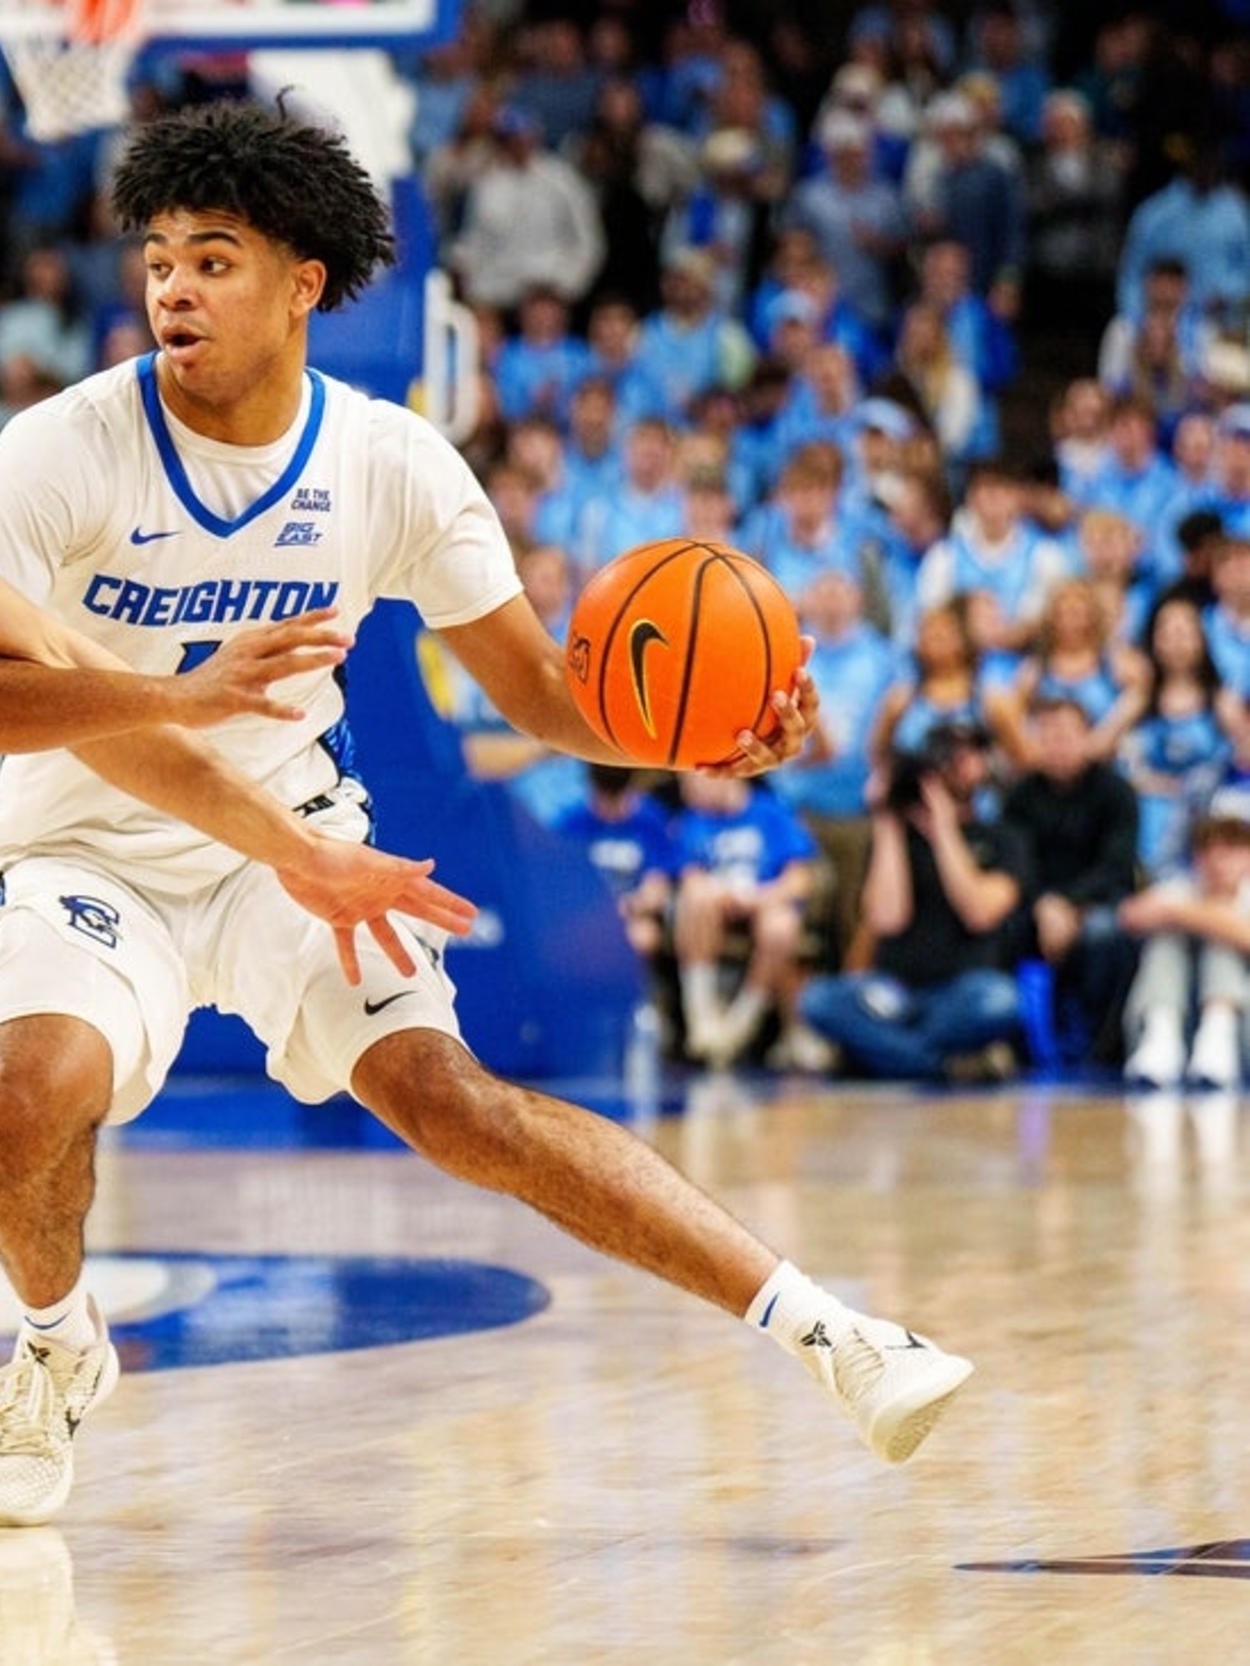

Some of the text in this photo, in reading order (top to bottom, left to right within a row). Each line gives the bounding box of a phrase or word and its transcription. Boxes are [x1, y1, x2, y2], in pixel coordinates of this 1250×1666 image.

[297, 488, 330, 500] BE THE
[291, 499, 331, 512] CHANGE
[284, 522, 316, 532] BIG
[276, 532, 323, 542] EAST
[82, 574, 339, 627] CREIGHTON
